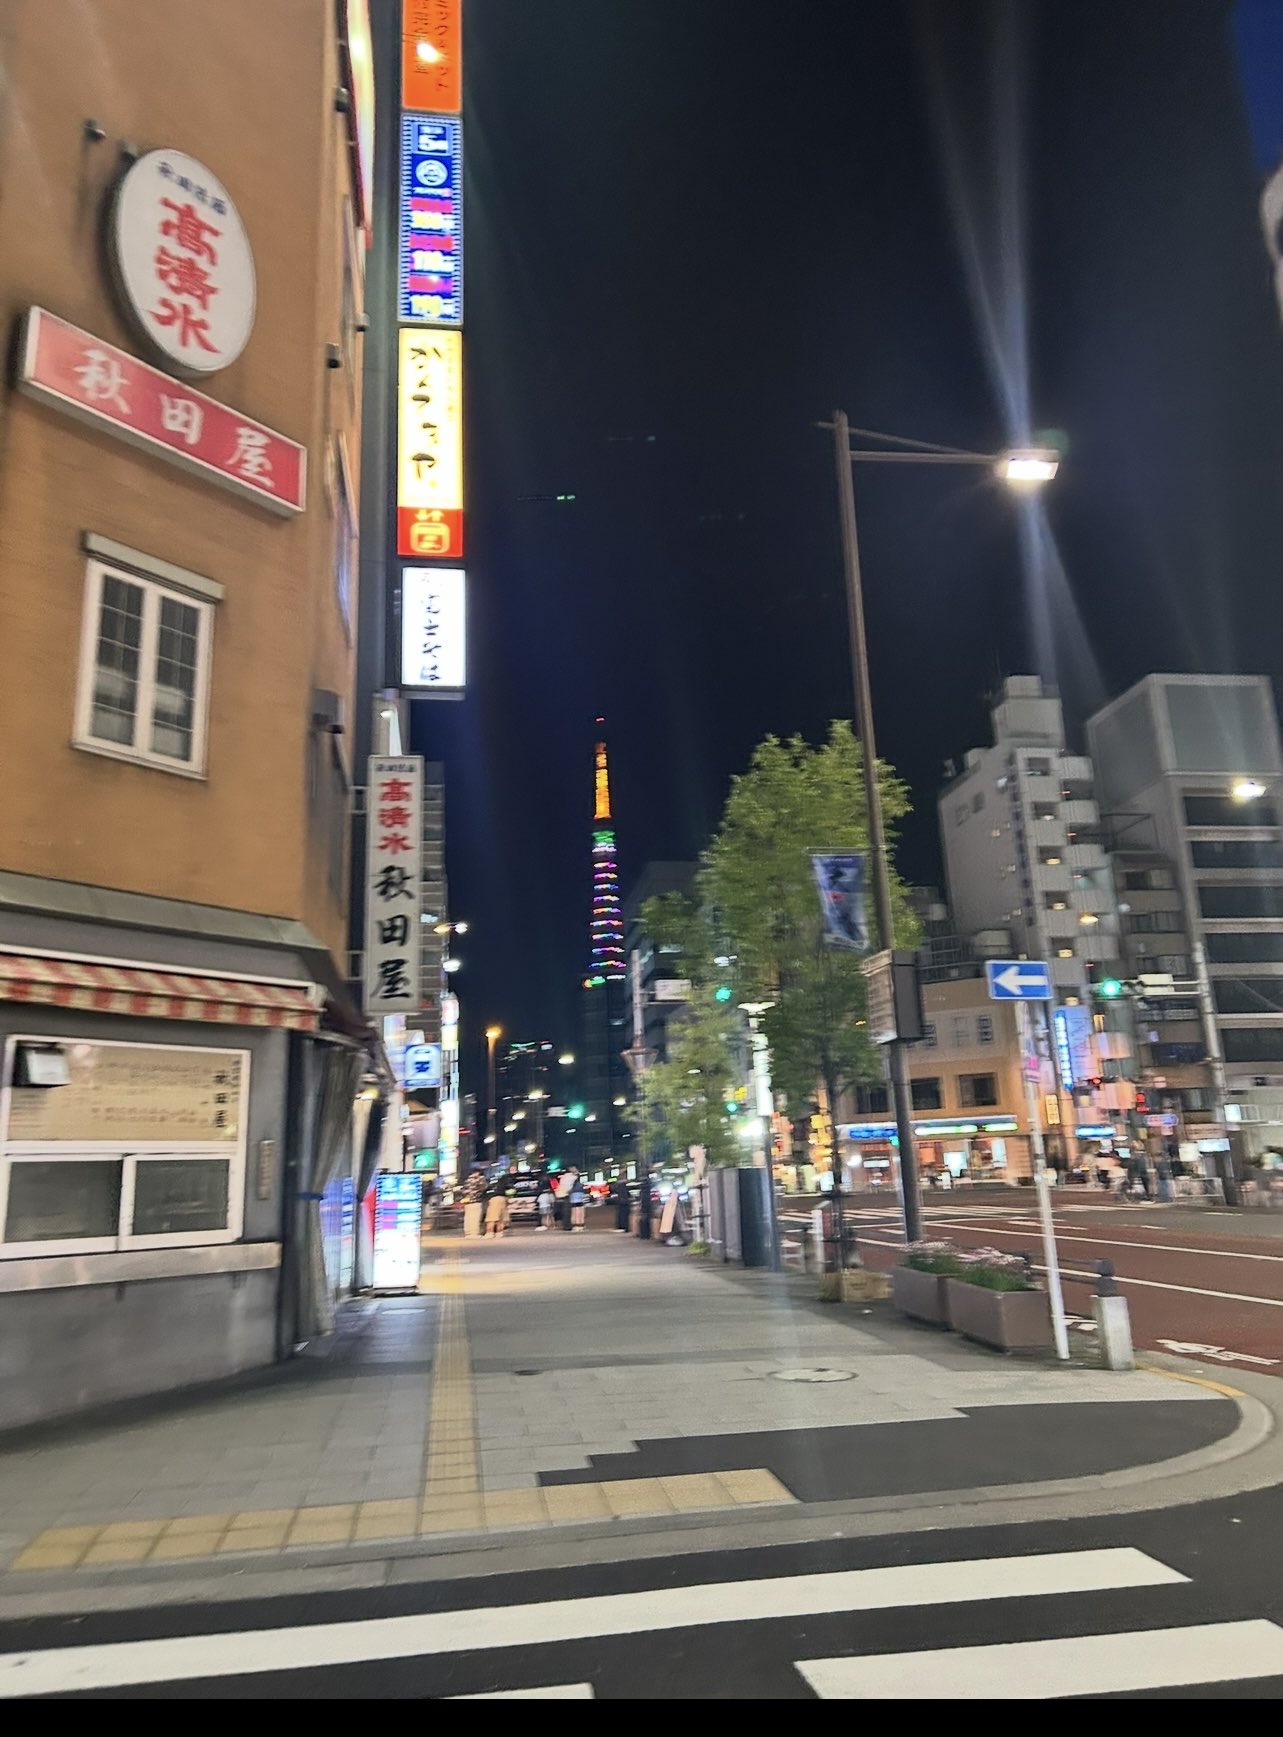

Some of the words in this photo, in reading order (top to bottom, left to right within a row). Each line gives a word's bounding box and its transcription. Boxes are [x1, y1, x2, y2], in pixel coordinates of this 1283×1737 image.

[74, 350, 274, 487] 秋田屋
[370, 865, 415, 999] 秋田屋
